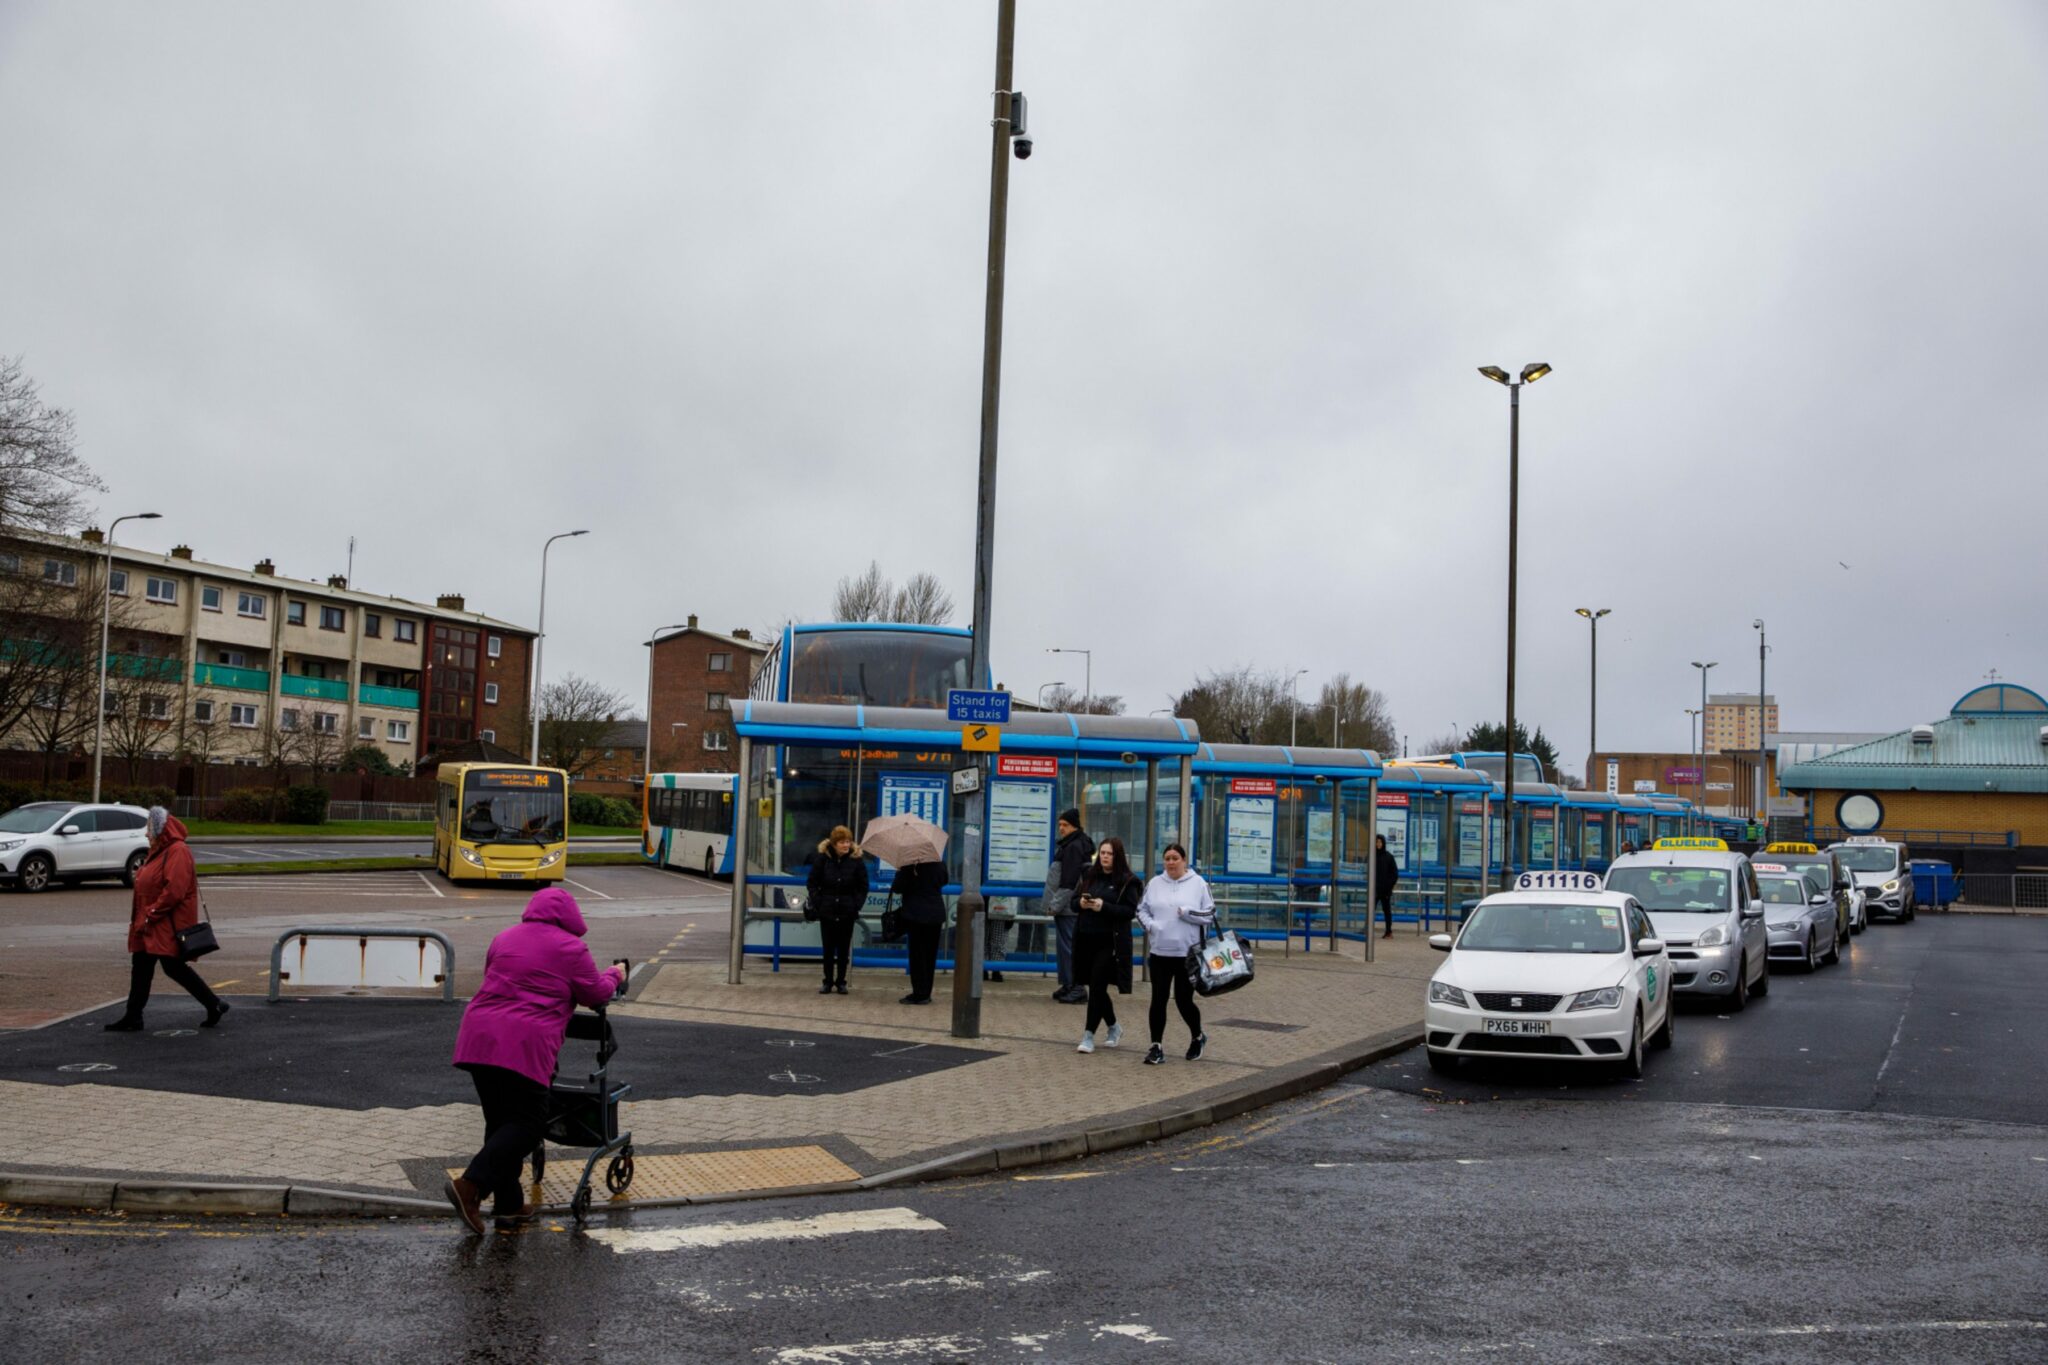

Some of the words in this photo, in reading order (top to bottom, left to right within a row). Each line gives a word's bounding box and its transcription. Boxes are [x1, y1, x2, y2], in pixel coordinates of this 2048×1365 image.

[952, 694, 986, 706] Stand
[990, 696, 1006, 707] for
[957, 707, 968, 718] 15
[973, 708, 1001, 720] taxis
[1660, 839, 1719, 848] BLUELINE
[1519, 873, 1596, 889] 611116
[1487, 1020, 1519, 1033] PX66
[1521, 1021, 1546, 1034] WHH
